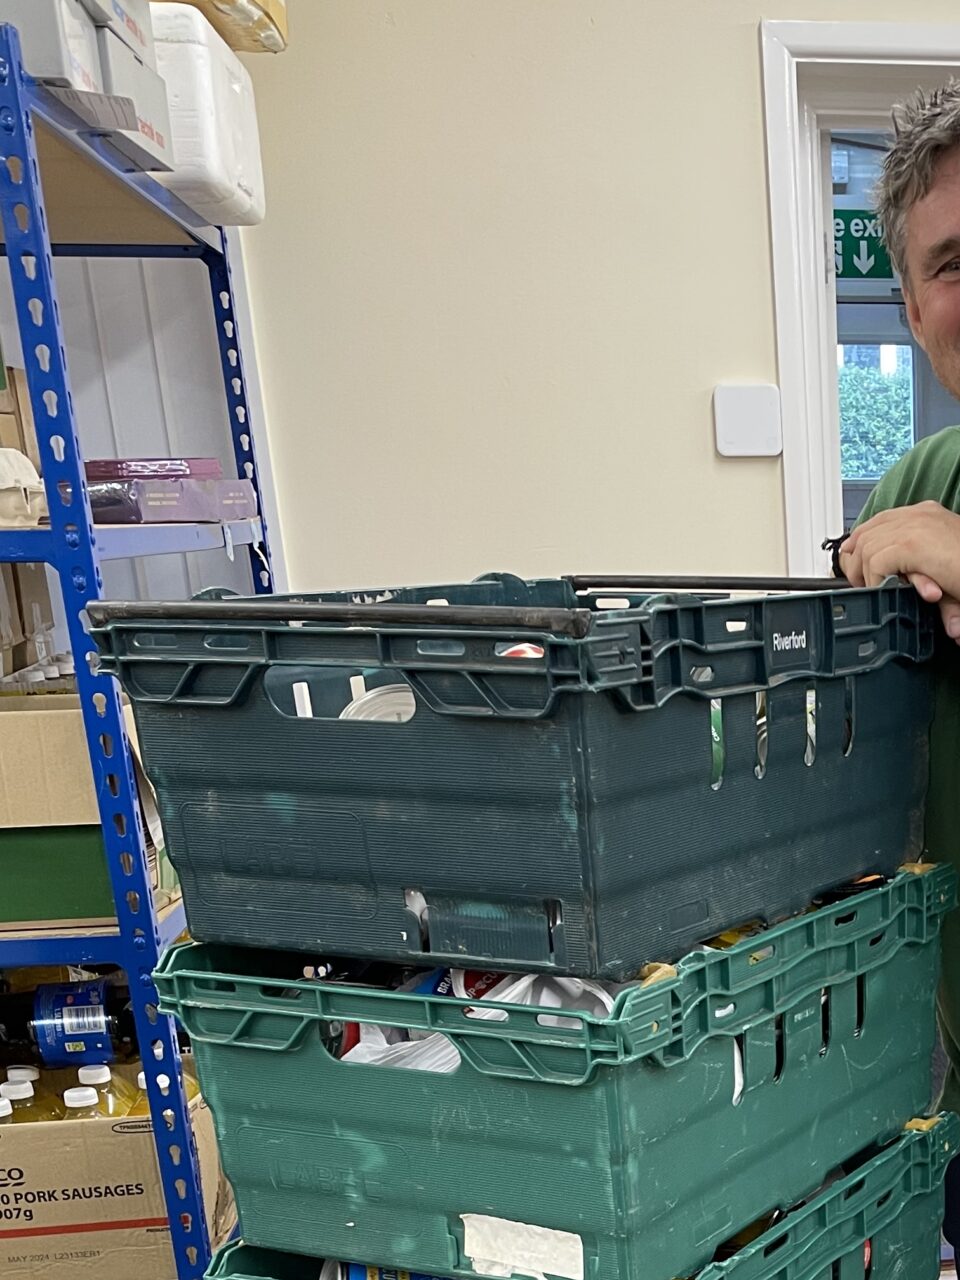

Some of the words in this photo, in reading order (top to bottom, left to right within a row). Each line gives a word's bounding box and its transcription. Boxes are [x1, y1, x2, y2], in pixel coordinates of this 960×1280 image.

[772, 630, 806, 651] Riverford
[14, 1190, 58, 1205] PORK
[62, 1183, 144, 1201] SAUSAGES
